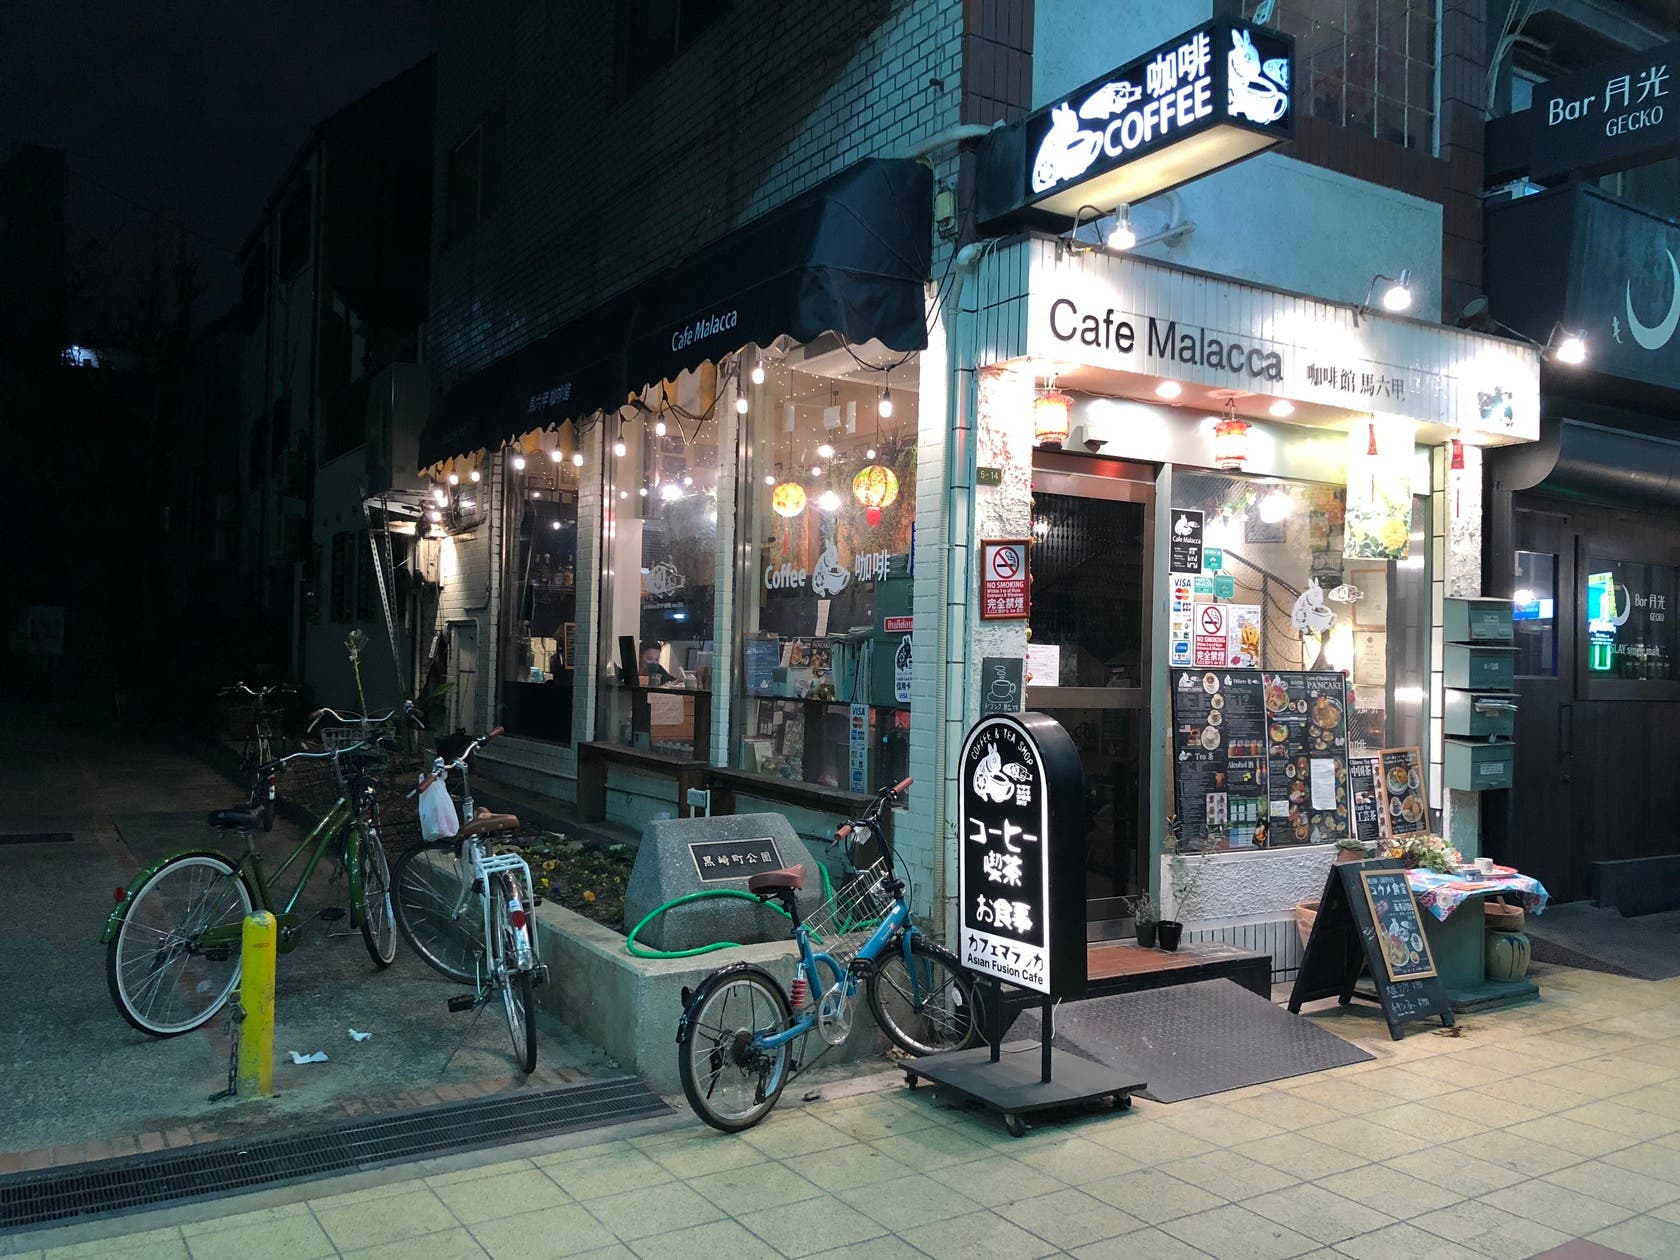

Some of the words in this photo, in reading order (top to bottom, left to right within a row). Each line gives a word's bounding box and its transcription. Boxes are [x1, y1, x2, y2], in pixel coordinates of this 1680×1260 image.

[1147, 32, 1210, 98] 咖啡
[1549, 95, 1595, 127] Bar
[1603, 64, 1670, 113] 月光
[1103, 77, 1213, 157] COFFEE
[1606, 105, 1664, 137] GECKO
[672, 325, 693, 351] Cafe
[694, 310, 738, 341] Malacca
[1050, 298, 1135, 354] Cafe
[1148, 316, 1283, 381] Malacca
[980, 470, 999, 480] 5-14
[764, 564, 807, 590] Coffee
[855, 549, 890, 582] 咖啡
[1175, 579, 1191, 587] VISA
[1634, 594, 1648, 607] Bar
[1649, 594, 1666, 609] 月光
[1307, 681, 1343, 689] PANCAKE
[971, 731, 992, 760] COFFEE
[994, 728, 1000, 739] &
[1003, 728, 1016, 744] TEA
[1018, 741, 1034, 765] SHOP
[1228, 761, 1247, 769] Alcohol
[969, 817, 1037, 853] コーヒー
[984, 850, 1022, 887] 喫茶
[976, 894, 1033, 933] お食事
[967, 953, 990, 968] Asian
[992, 960, 1020, 977] Fusion
[1022, 969, 1043, 985] Cafe
